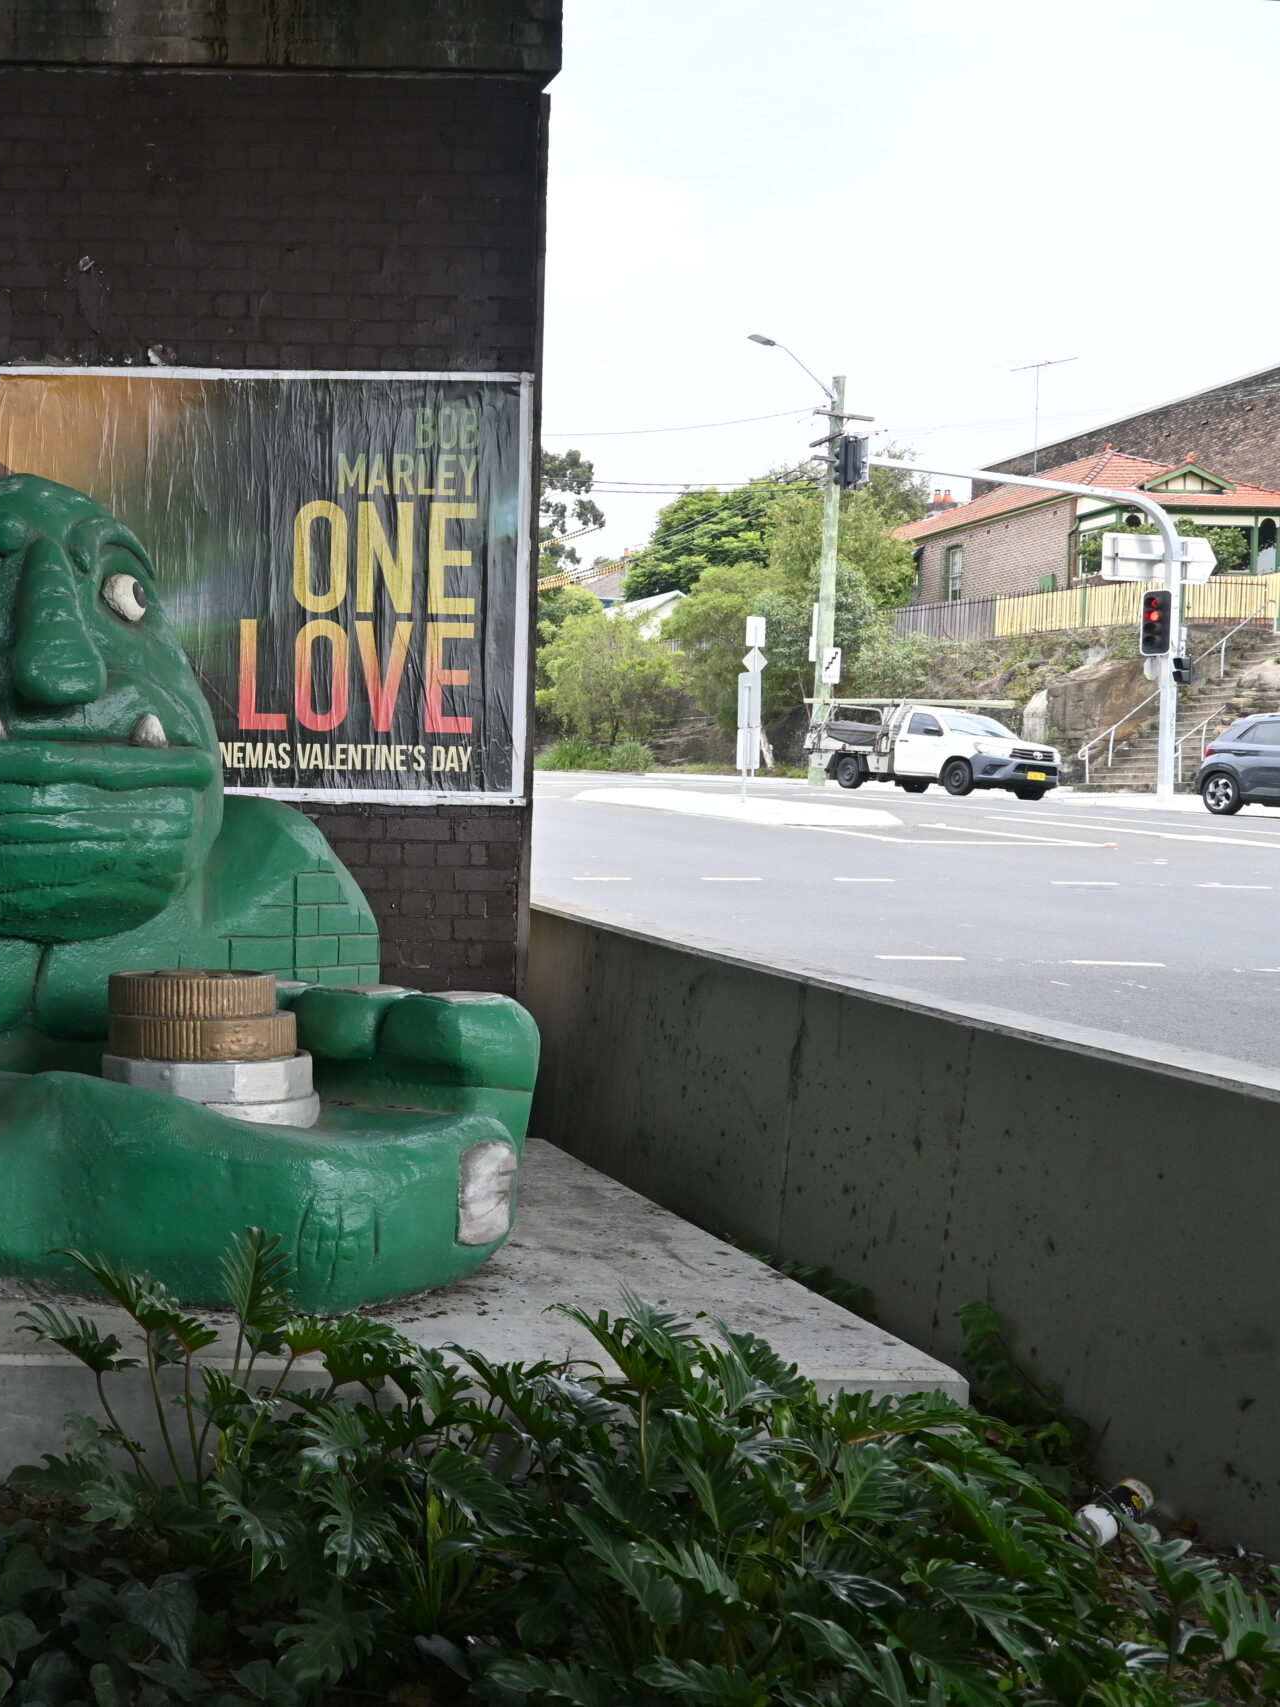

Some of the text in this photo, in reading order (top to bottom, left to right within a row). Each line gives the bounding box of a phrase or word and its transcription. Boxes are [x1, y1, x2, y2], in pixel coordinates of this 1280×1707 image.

[415, 407, 481, 450] BOB
[337, 453, 480, 496] MARLEY
[293, 500, 477, 615] ONE
[238, 618, 475, 734] LOVE
[219, 742, 473, 773] NEMAS VALENTINE'S DAY
